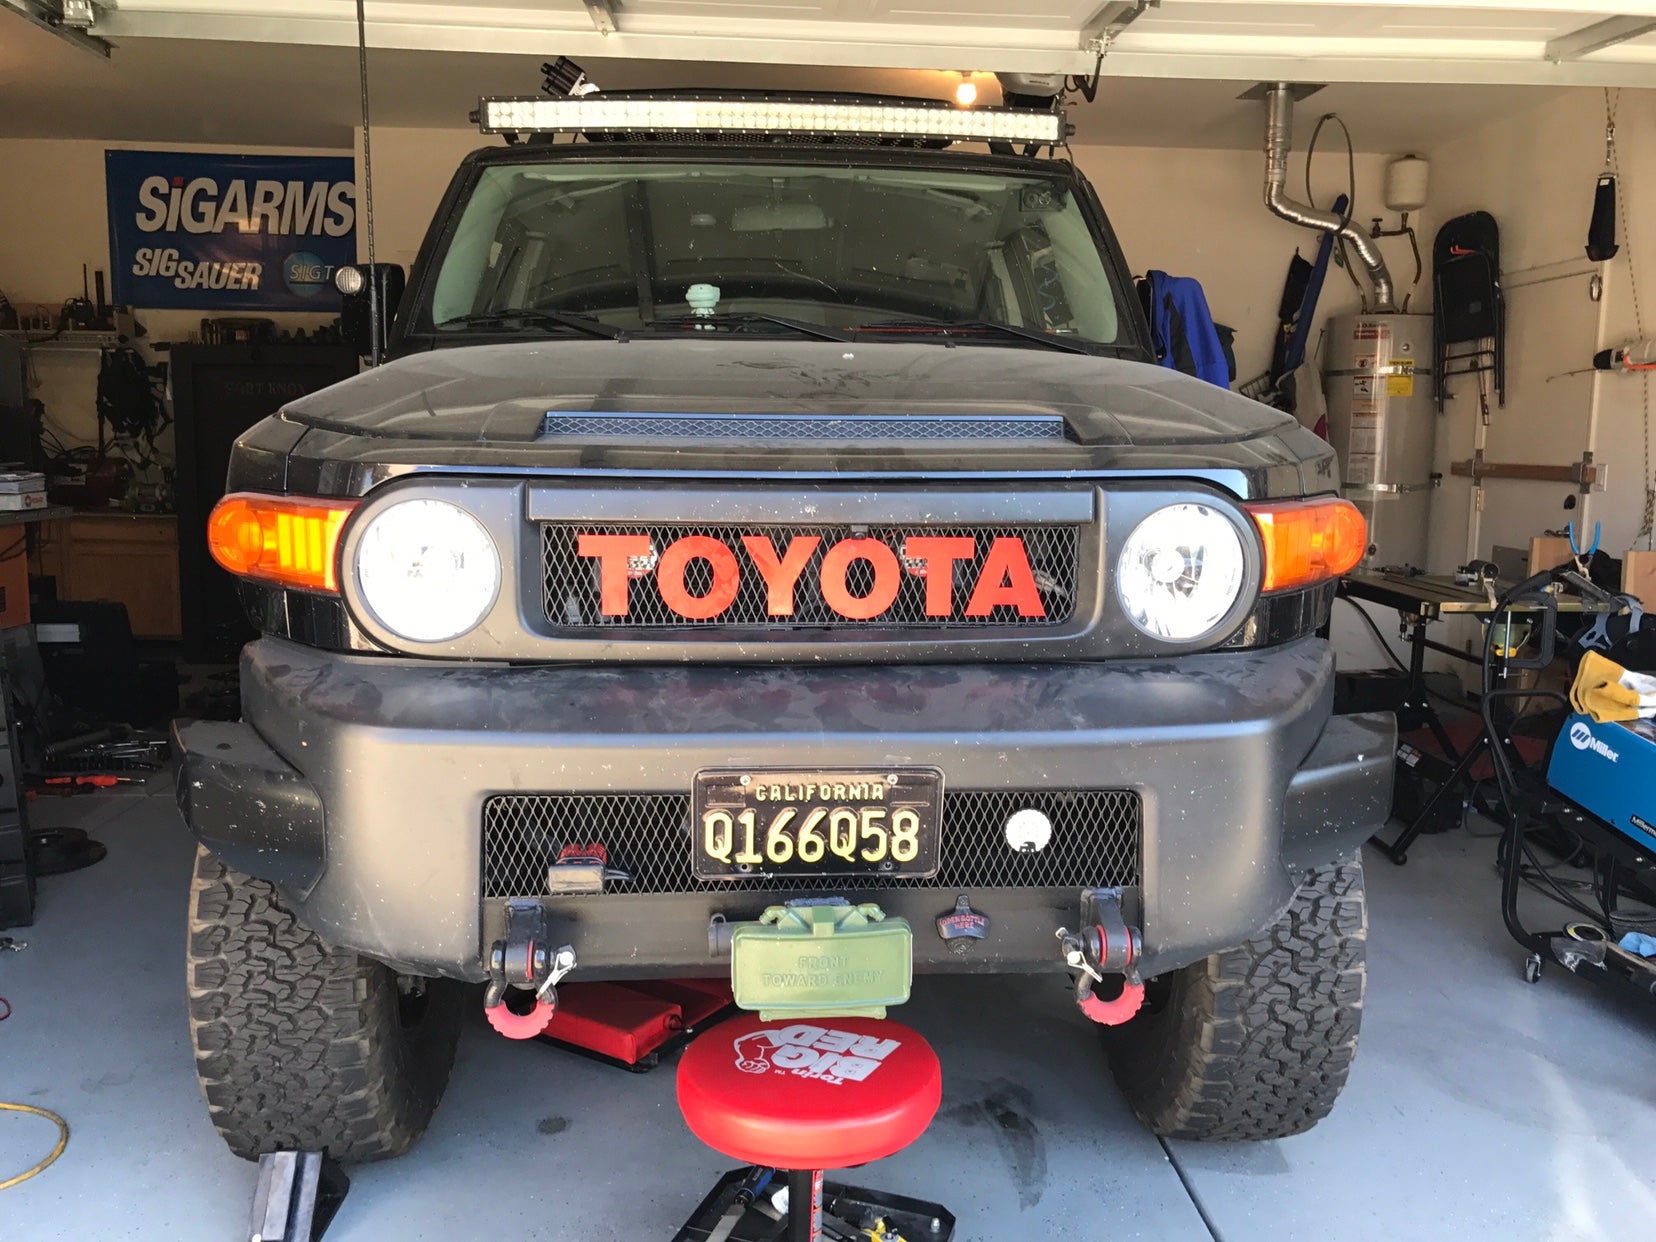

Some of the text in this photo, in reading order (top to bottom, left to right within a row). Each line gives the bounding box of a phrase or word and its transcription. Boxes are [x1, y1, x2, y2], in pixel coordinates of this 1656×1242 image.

[133, 247, 262, 290] SIG SAUER
[578, 534, 1046, 619] TOYOTA
[1590, 737, 1619, 763] Miller
[755, 783, 884, 802] CALIFORNIA
[703, 806, 920, 864] Q166Q58
[940, 914, 985, 926] OPEN BOTTLE
[954, 921, 975, 929] HERE
[798, 956, 848, 969] FRONT
[762, 969, 884, 987] TOWARD ENEMY
[778, 1024, 902, 1060] RED
[771, 1044, 882, 1081] BIG
[791, 1067, 844, 1085] Torin
